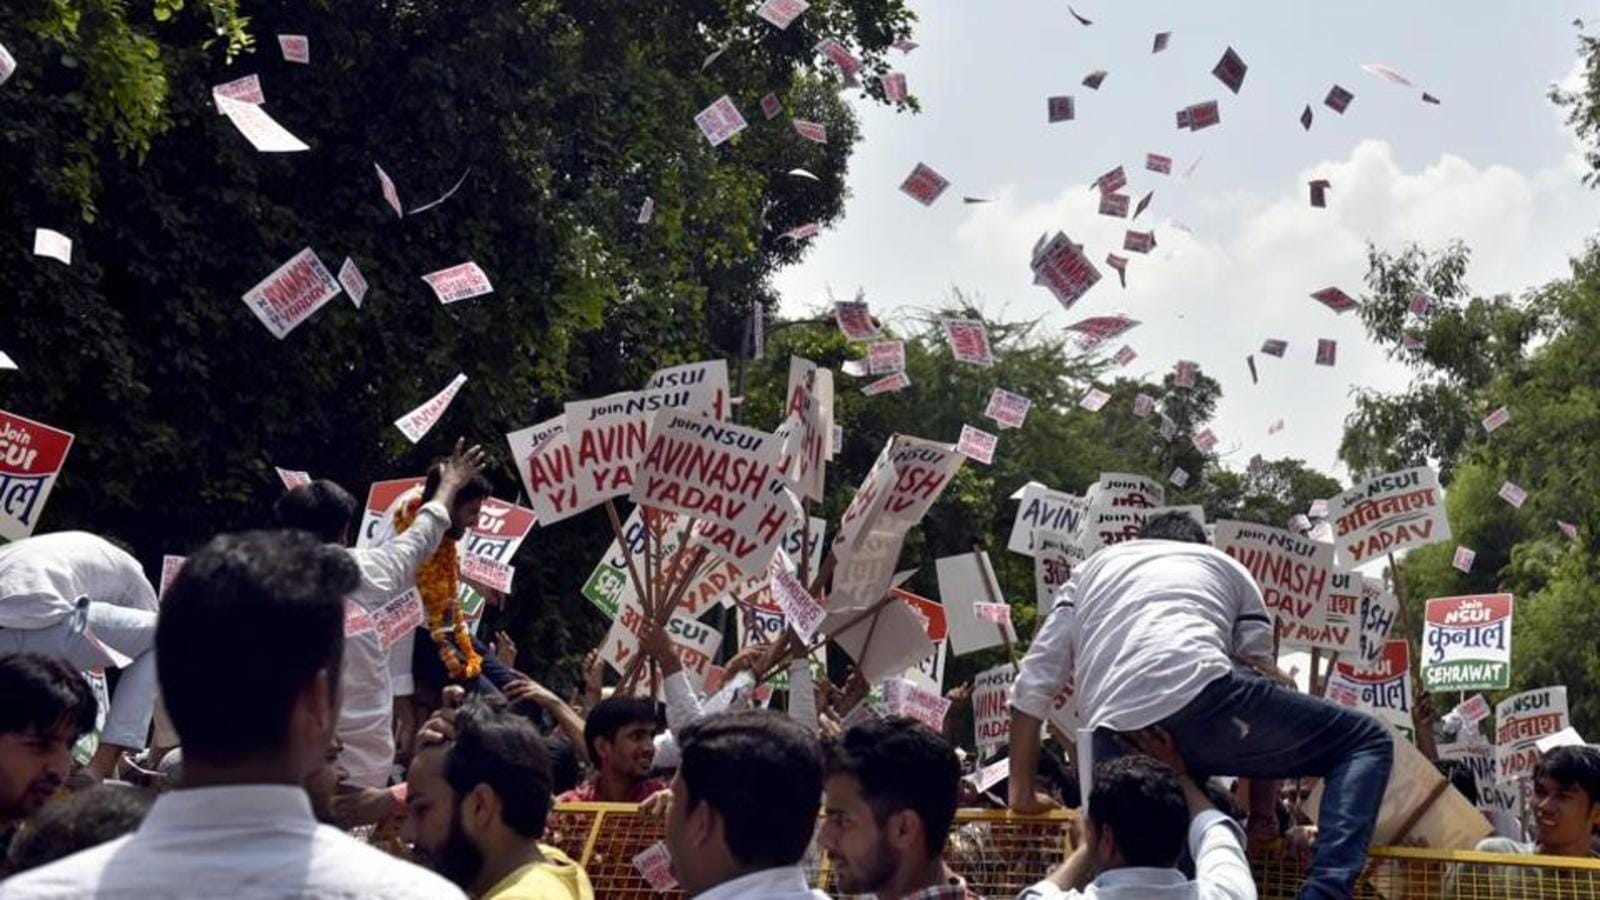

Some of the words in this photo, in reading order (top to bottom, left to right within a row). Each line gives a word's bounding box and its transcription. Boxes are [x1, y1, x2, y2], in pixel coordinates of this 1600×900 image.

[625, 390, 690, 416] NSUI
[701, 424, 763, 452] NSUI
[643, 434, 770, 500] AVINASH
[1367, 471, 1420, 497] NSUI
[645, 475, 748, 522] YADAV
[1267, 532, 1318, 558] NSUI
[1347, 519, 1433, 560] YADAV
[1444, 608, 1492, 624] NSUI
[1428, 620, 1506, 664] कुनाल
[1427, 663, 1504, 685] SEHRAWAT
[1513, 692, 1551, 712] NSUI
